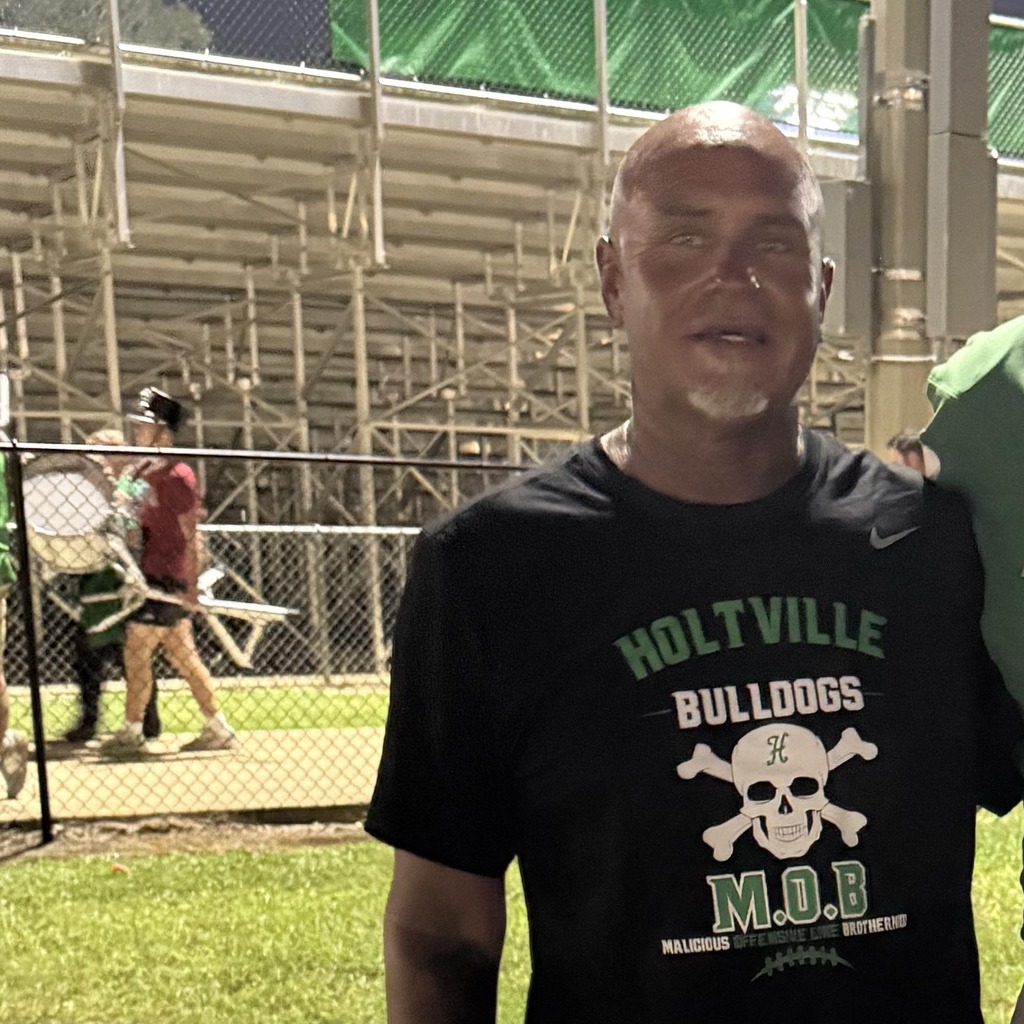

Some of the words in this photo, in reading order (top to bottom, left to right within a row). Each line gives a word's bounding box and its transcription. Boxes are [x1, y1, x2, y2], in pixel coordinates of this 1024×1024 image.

[612, 596, 888, 681] HOLTVILLE
[671, 676, 865, 729] BULLDOGS
[766, 732, 789, 766] H
[661, 936, 730, 955] MALICIOUS
